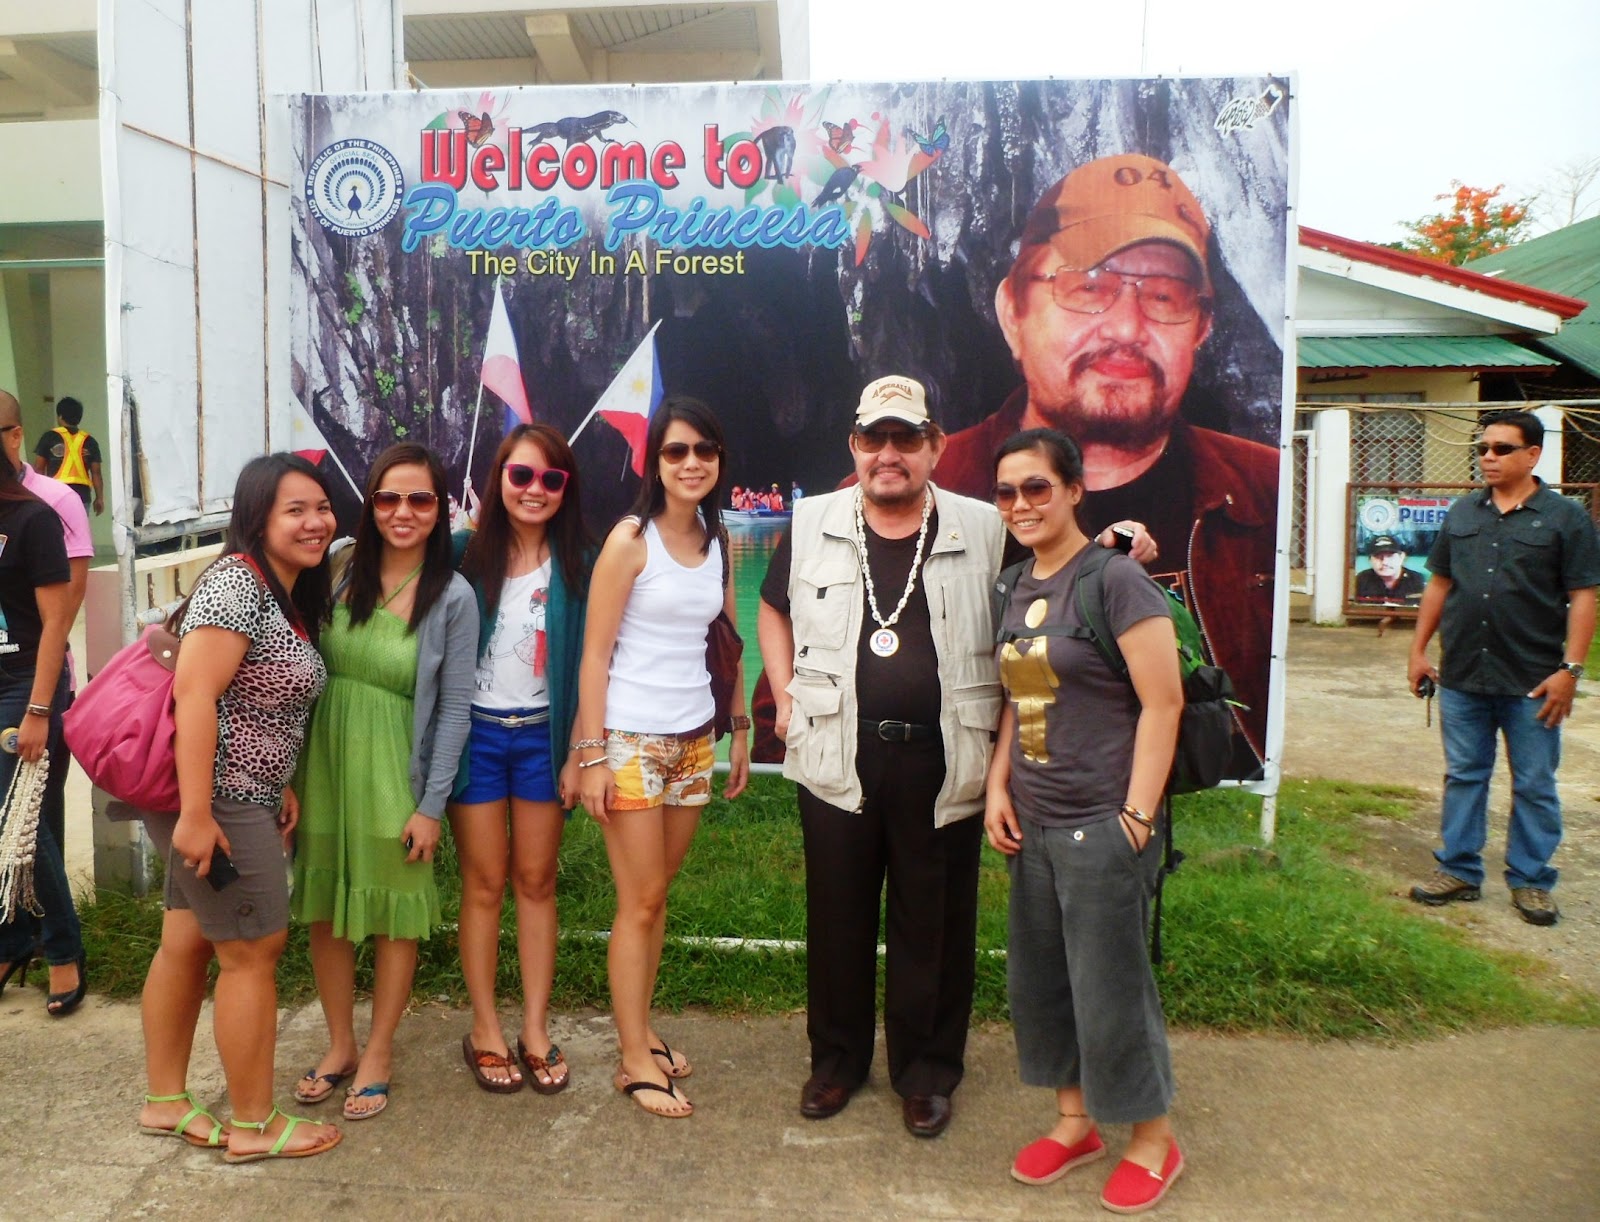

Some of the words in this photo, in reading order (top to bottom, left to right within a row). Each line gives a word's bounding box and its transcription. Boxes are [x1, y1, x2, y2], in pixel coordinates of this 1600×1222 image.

[307, 148, 333, 186] REPUBLIC
[334, 142, 345, 151] OF
[348, 140, 366, 148] THE
[367, 142, 402, 186] PHILIPPINES
[330, 150, 360, 164] OFFICIAL
[362, 151, 378, 163] SEAL
[420, 126, 687, 191] Welcome
[703, 123, 763, 189] to
[308, 199, 322, 219] CITY
[320, 218, 332, 228] OF
[331, 225, 369, 237] PUERTO
[368, 198, 402, 233] PRINCESA
[401, 181, 586, 253] Puerto
[602, 179, 848, 251] Princesa
[466, 250, 517, 275] The
[526, 250, 580, 281] City
[591, 250, 615, 275] In
[624, 250, 646, 275] A
[655, 250, 745, 275] Forest
